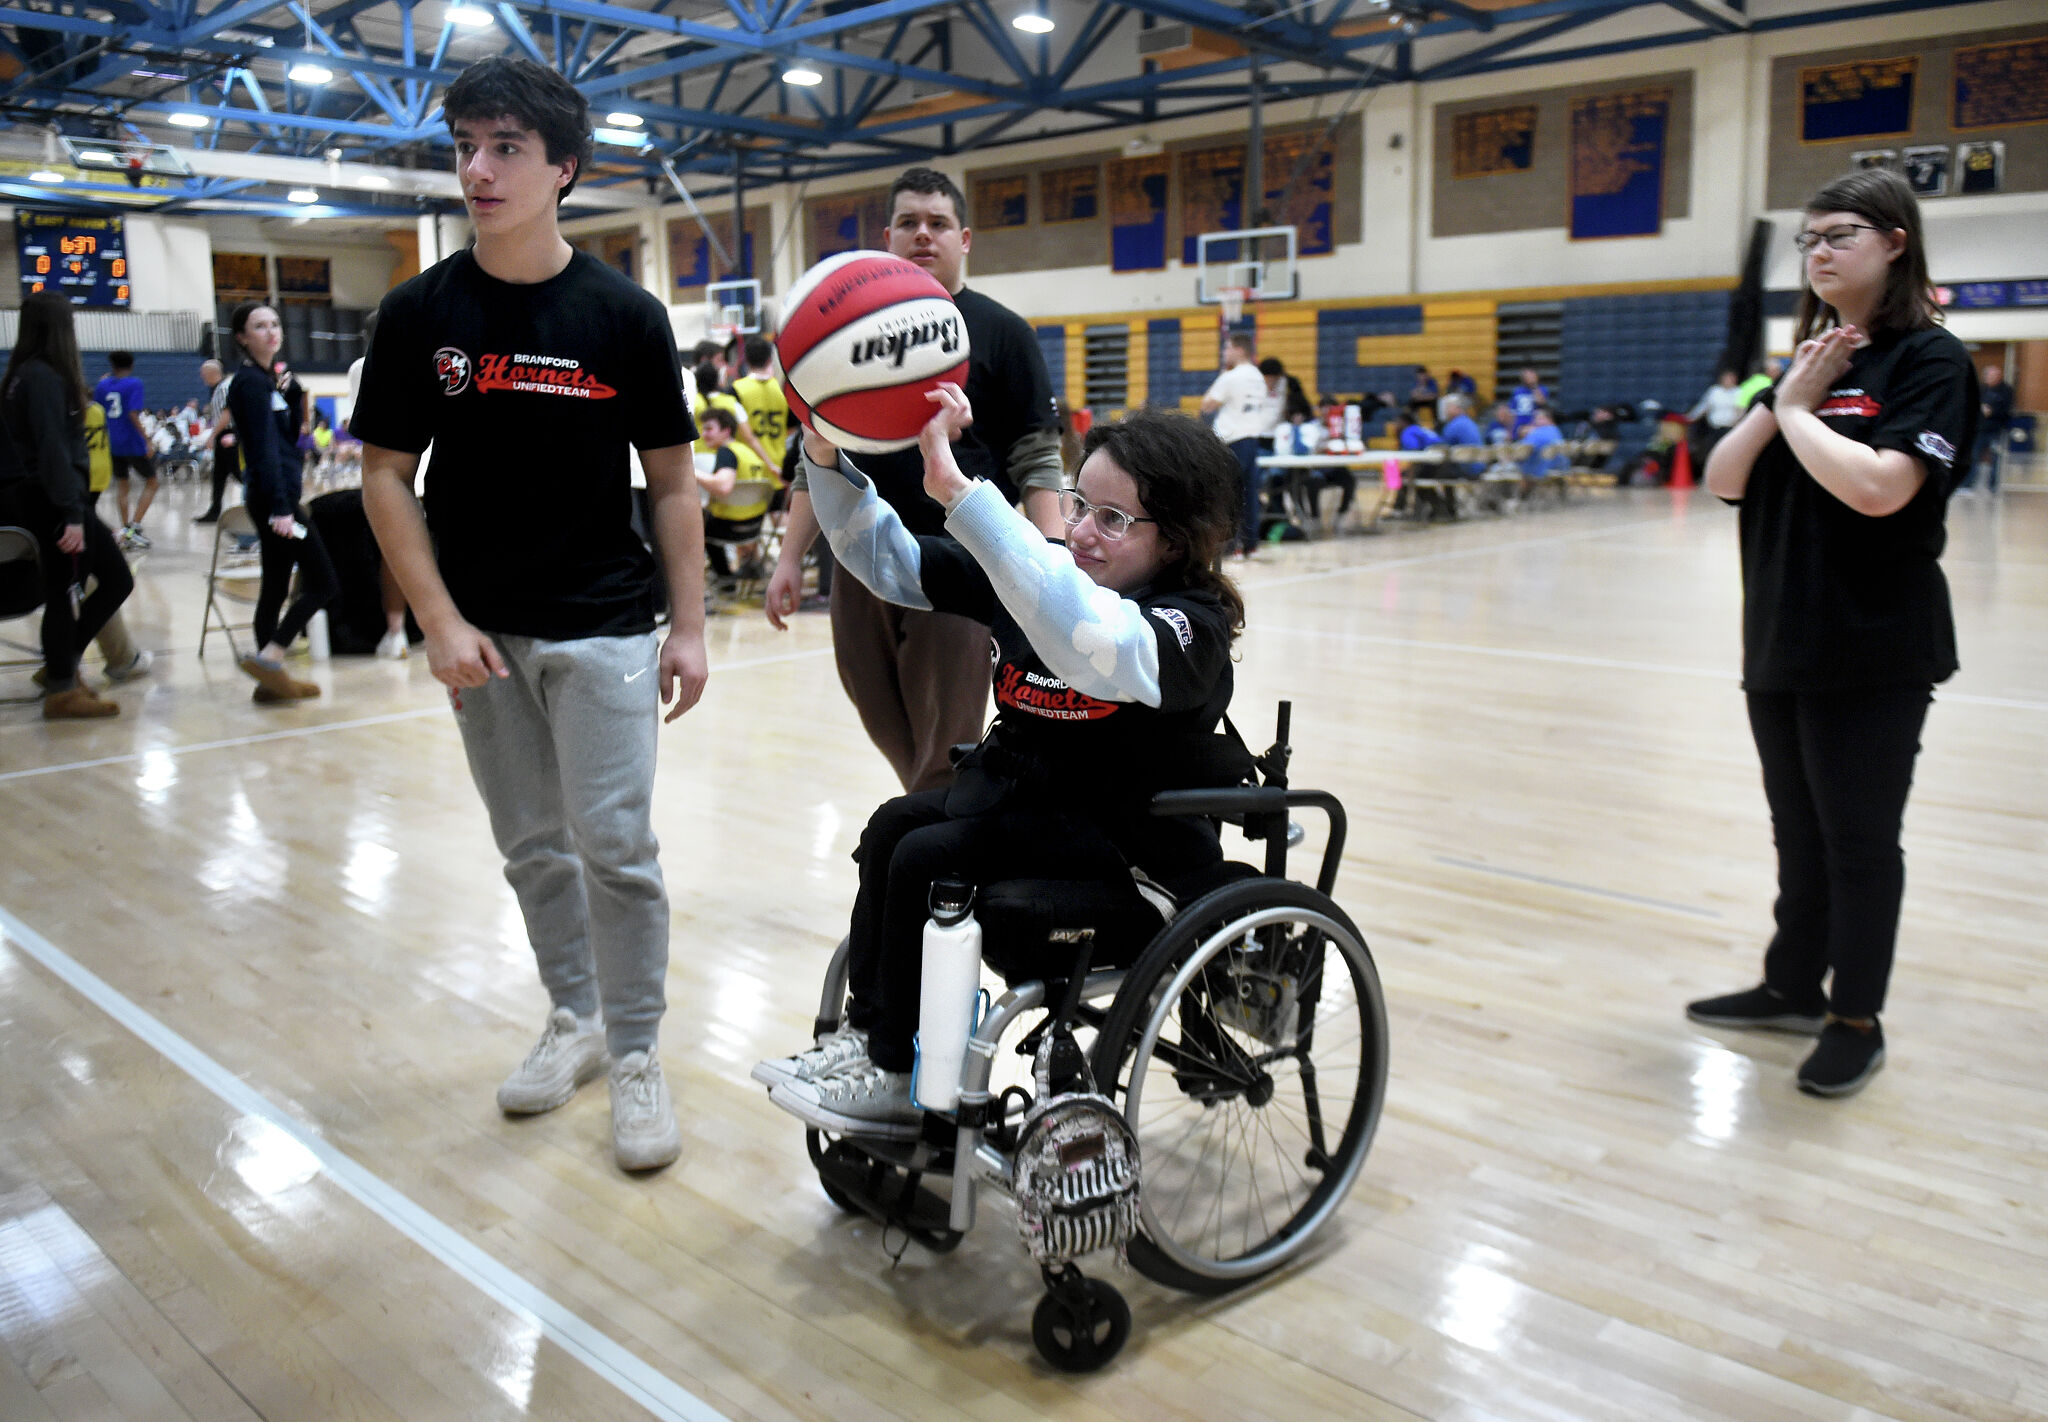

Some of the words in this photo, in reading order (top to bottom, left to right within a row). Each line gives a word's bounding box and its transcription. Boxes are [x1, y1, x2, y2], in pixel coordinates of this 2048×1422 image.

[36, 255, 51, 274] 0
[112, 258, 126, 278] 0
[850, 315, 960, 369] Baden
[474, 353, 598, 388] Hornets
[513, 353, 580, 369] BRANFORD
[512, 381, 590, 398] UNIFIEDTEAM
[105, 391, 123, 419] 3
[752, 410, 782, 439] 35
[1015, 700, 1089, 720] UNIFIEDTEAM
